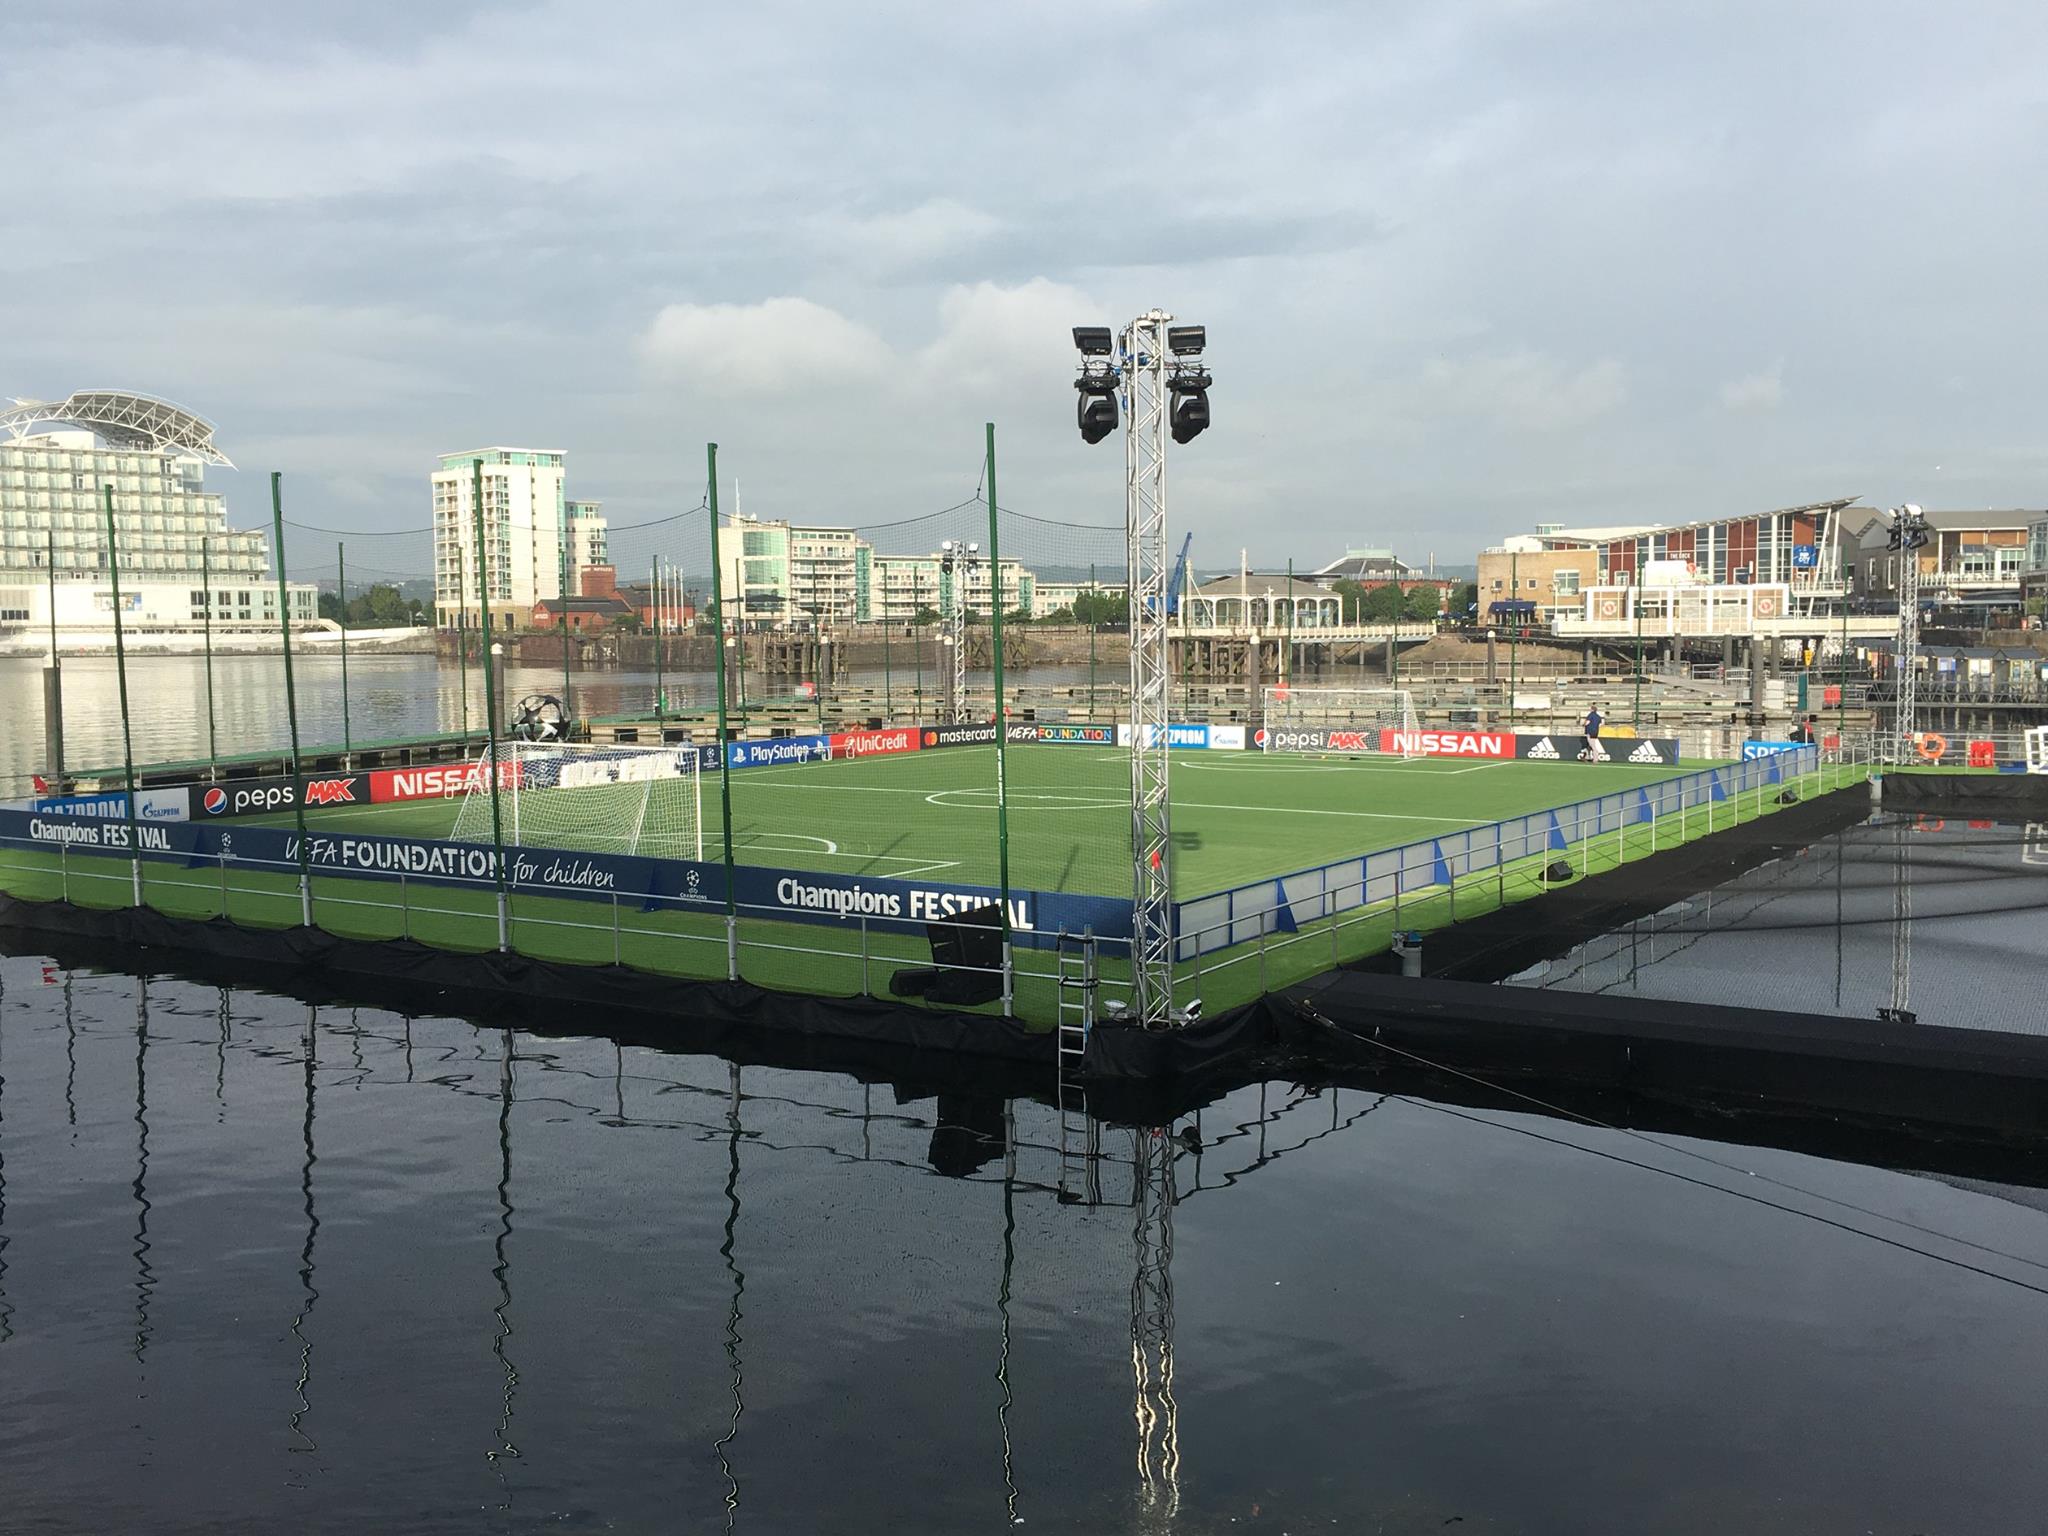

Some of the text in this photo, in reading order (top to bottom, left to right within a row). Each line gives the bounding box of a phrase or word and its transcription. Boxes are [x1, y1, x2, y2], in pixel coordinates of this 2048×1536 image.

[856, 732, 908, 753] UniCredit
[940, 724, 996, 743] mastercard
[1007, 725, 1112, 741] UEFA FOUNDATION
[1275, 731, 1368, 749] pepsi MAX
[751, 742, 809, 765] PlayStation
[1394, 734, 1501, 755] NISSAN
[1528, 748, 1560, 760] adidas
[1628, 752, 1663, 764] adidas
[235, 786, 295, 812] peps
[305, 777, 356, 805] MAX
[29, 819, 99, 847] Champions
[513, 853, 539, 888] for
[543, 860, 615, 888] children
[776, 877, 900, 919] Champions
